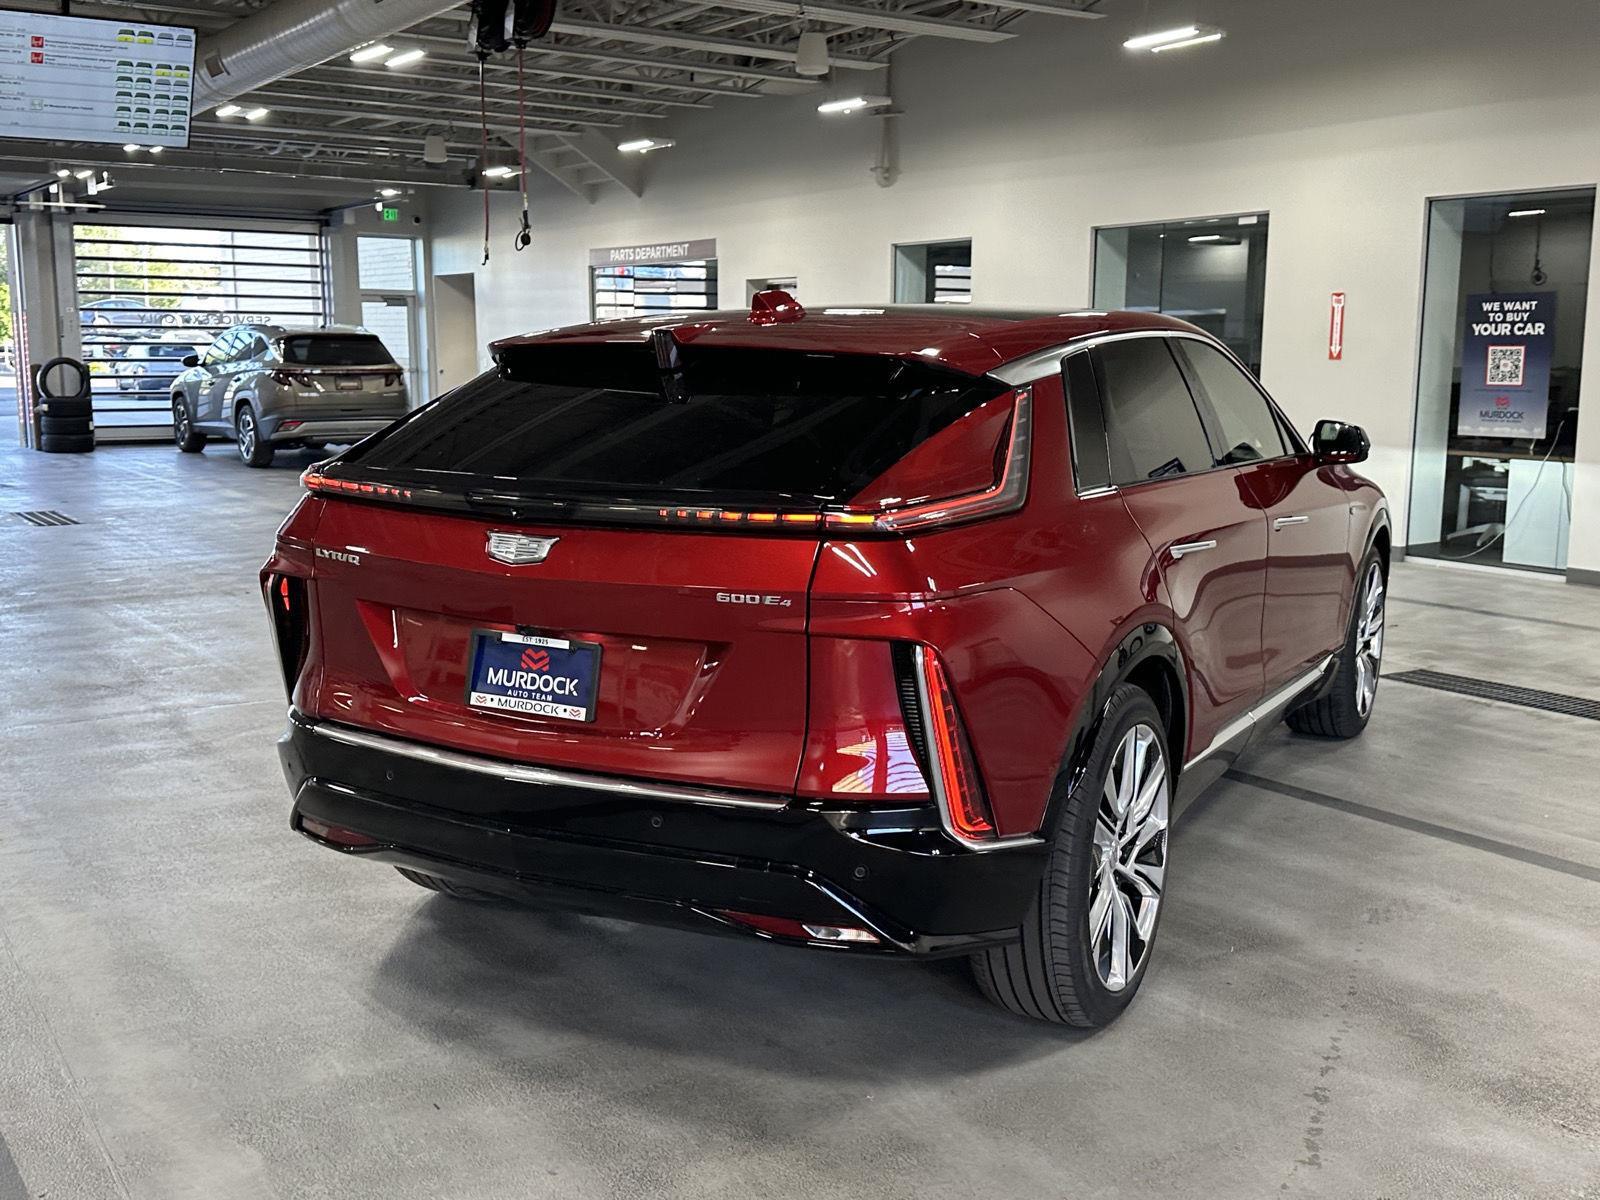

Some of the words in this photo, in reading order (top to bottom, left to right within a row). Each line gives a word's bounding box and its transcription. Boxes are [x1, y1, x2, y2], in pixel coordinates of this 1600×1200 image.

[610, 248, 634, 260] PARTS
[635, 244, 689, 260] DEPARTMENT
[1482, 302, 1501, 312] WE
[1503, 301, 1538, 311] WANT
[1488, 312, 1504, 322] TO
[1506, 312, 1530, 321] BUY
[1472, 323, 1511, 336] YOUR
[1513, 322, 1545, 335] CAR
[1480, 410, 1524, 419] MURDOCK
[716, 592, 760, 604] 600
[534, 637, 549, 645] 1925
[487, 667, 579, 697] MURDOCK
[507, 689, 529, 699] AUTO
[531, 692, 553, 702] TEAM
[497, 697, 560, 715] MURDOCK
